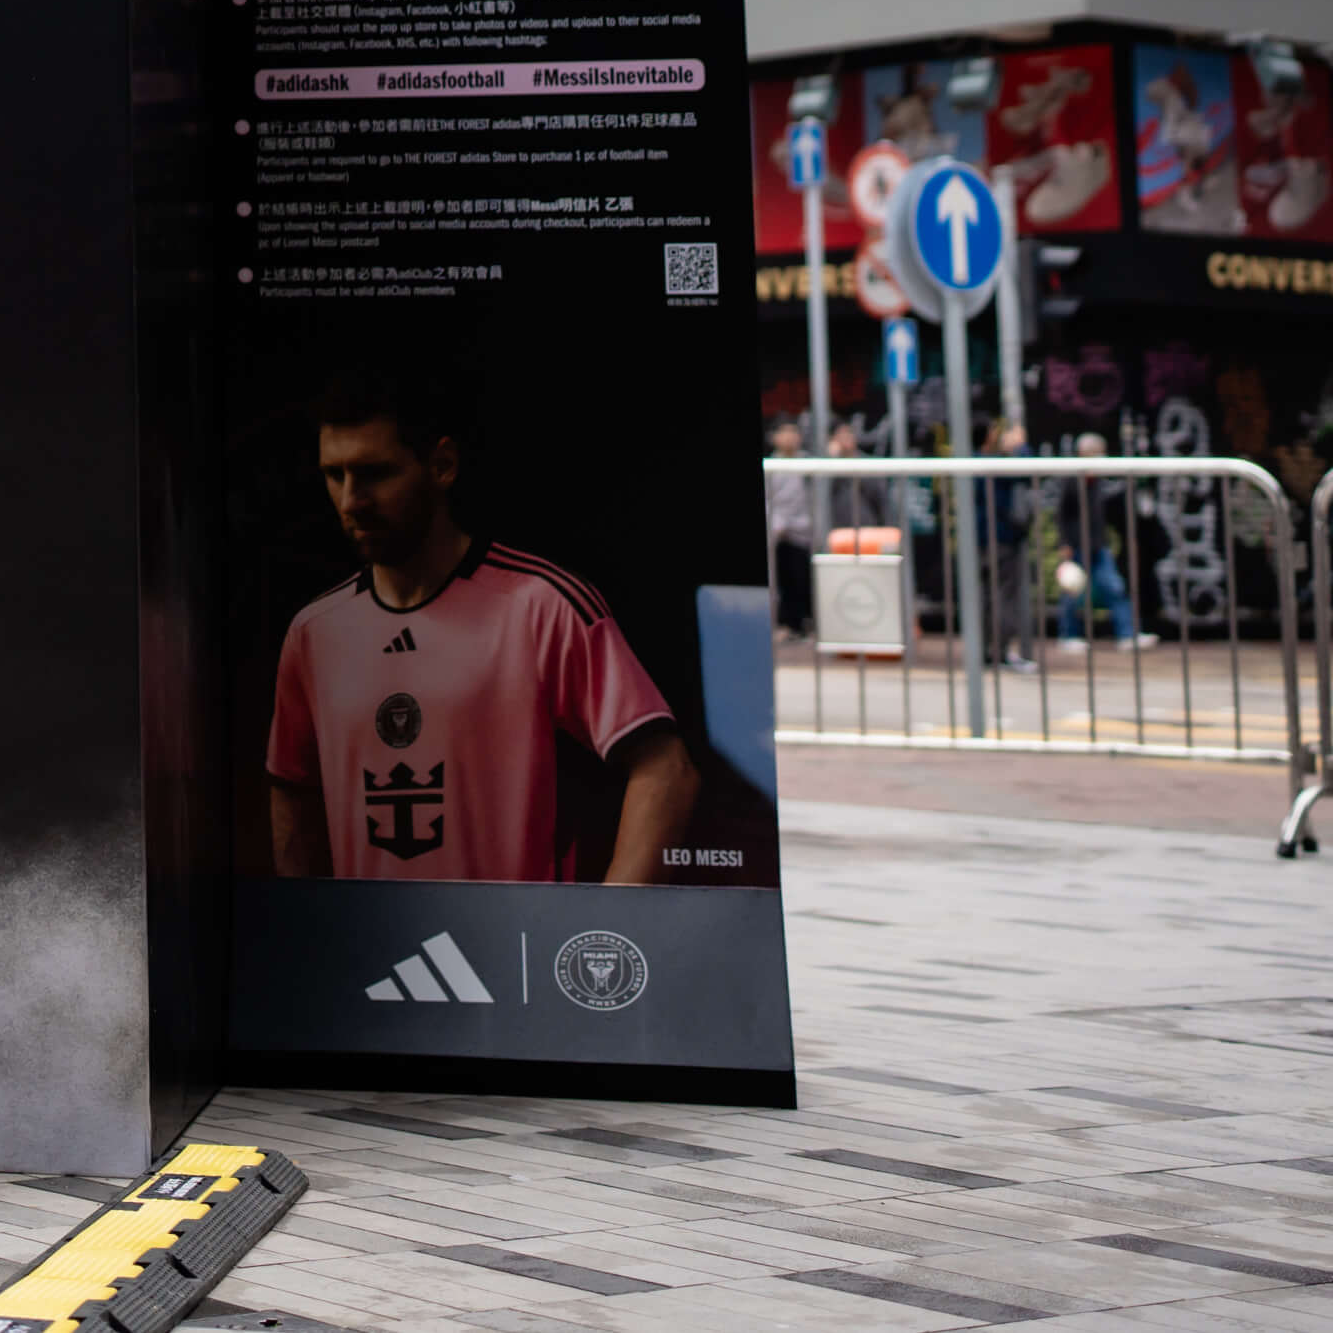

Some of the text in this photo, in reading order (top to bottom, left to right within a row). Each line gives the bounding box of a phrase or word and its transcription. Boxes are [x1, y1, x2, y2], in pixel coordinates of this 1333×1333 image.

[571, 17, 604, 30] upload
[605, 16, 616, 27] to
[617, 15, 640, 26] their
[641, 14, 669, 26] social
[671, 14, 702, 26] media
[265, 65, 694, 93] #adidashk #adidasfootball #MessiIsInevitable
[405, 152, 421, 164] THE
[424, 152, 457, 164] FOREST
[492, 150, 517, 162] Store
[518, 150, 529, 162] to
[530, 150, 573, 164] purchase
[597, 149, 608, 161] of
[609, 148, 645, 161] football
[512, 218, 541, 231] during
[589, 216, 645, 229] participants
[647, 217, 664, 227] can
[663, 848, 743, 868] LEO MESSI
